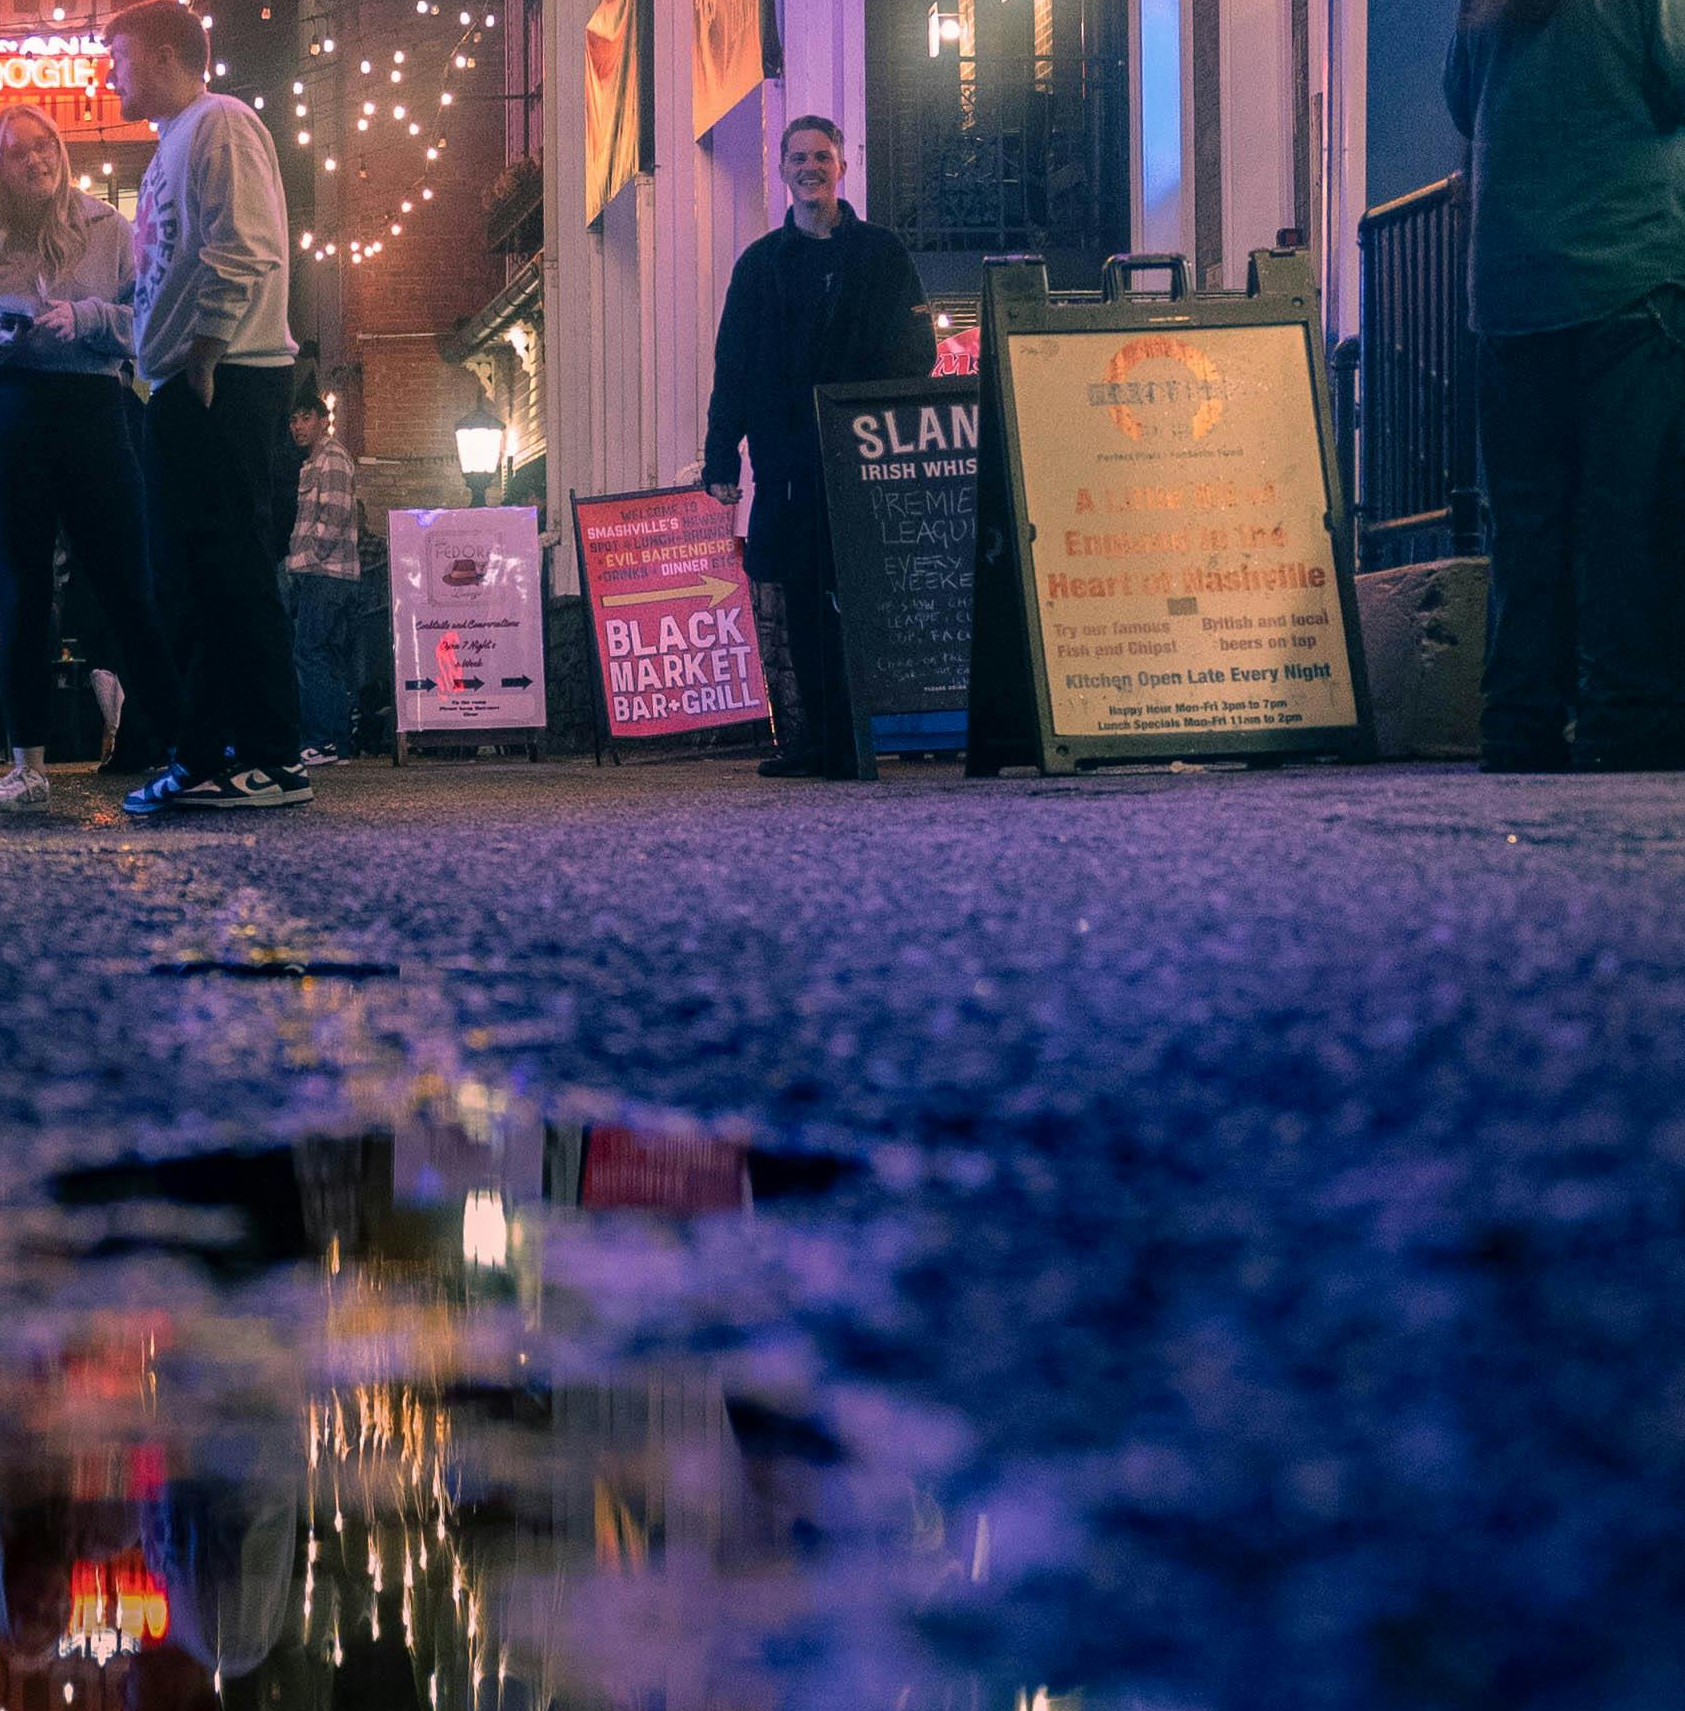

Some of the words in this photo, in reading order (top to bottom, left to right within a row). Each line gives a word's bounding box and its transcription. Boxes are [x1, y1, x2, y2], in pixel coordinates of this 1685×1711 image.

[861, 463, 916, 481] IRISH
[620, 504, 679, 522] WELCOME
[587, 517, 680, 540] SMASHVILLE'S
[589, 540, 619, 553] SPOT
[605, 552, 640, 568] EVIL
[642, 539, 735, 564] BARTENDERS
[660, 557, 709, 577] DINNER
[1047, 570, 1133, 600] Heart
[1182, 560, 1326, 596] Nashville
[1202, 616, 1253, 632] British
[1258, 614, 1287, 628] and
[1291, 608, 1329, 627] local
[606, 607, 746, 658] BLACK
[1220, 636, 1263, 652] beers
[1268, 637, 1287, 650] on
[1291, 633, 1317, 651] tap
[1057, 643, 1090, 659] Fish
[1095, 642, 1123, 657] and
[609, 645, 752, 694] MARKET
[1066, 672, 1133, 690] Kitchen
[1138, 670, 1183, 688] Open
[1188, 668, 1225, 685] Late
[1231, 665, 1279, 684] Every
[1284, 662, 1332, 682] Night
[613, 681, 761, 722] BAR+GRILL
[1109, 704, 1144, 718] Happy
[1175, 700, 1220, 713] Mon-Fri
[1097, 720, 1132, 732] Lunch
[1134, 717, 1181, 732] Specials
